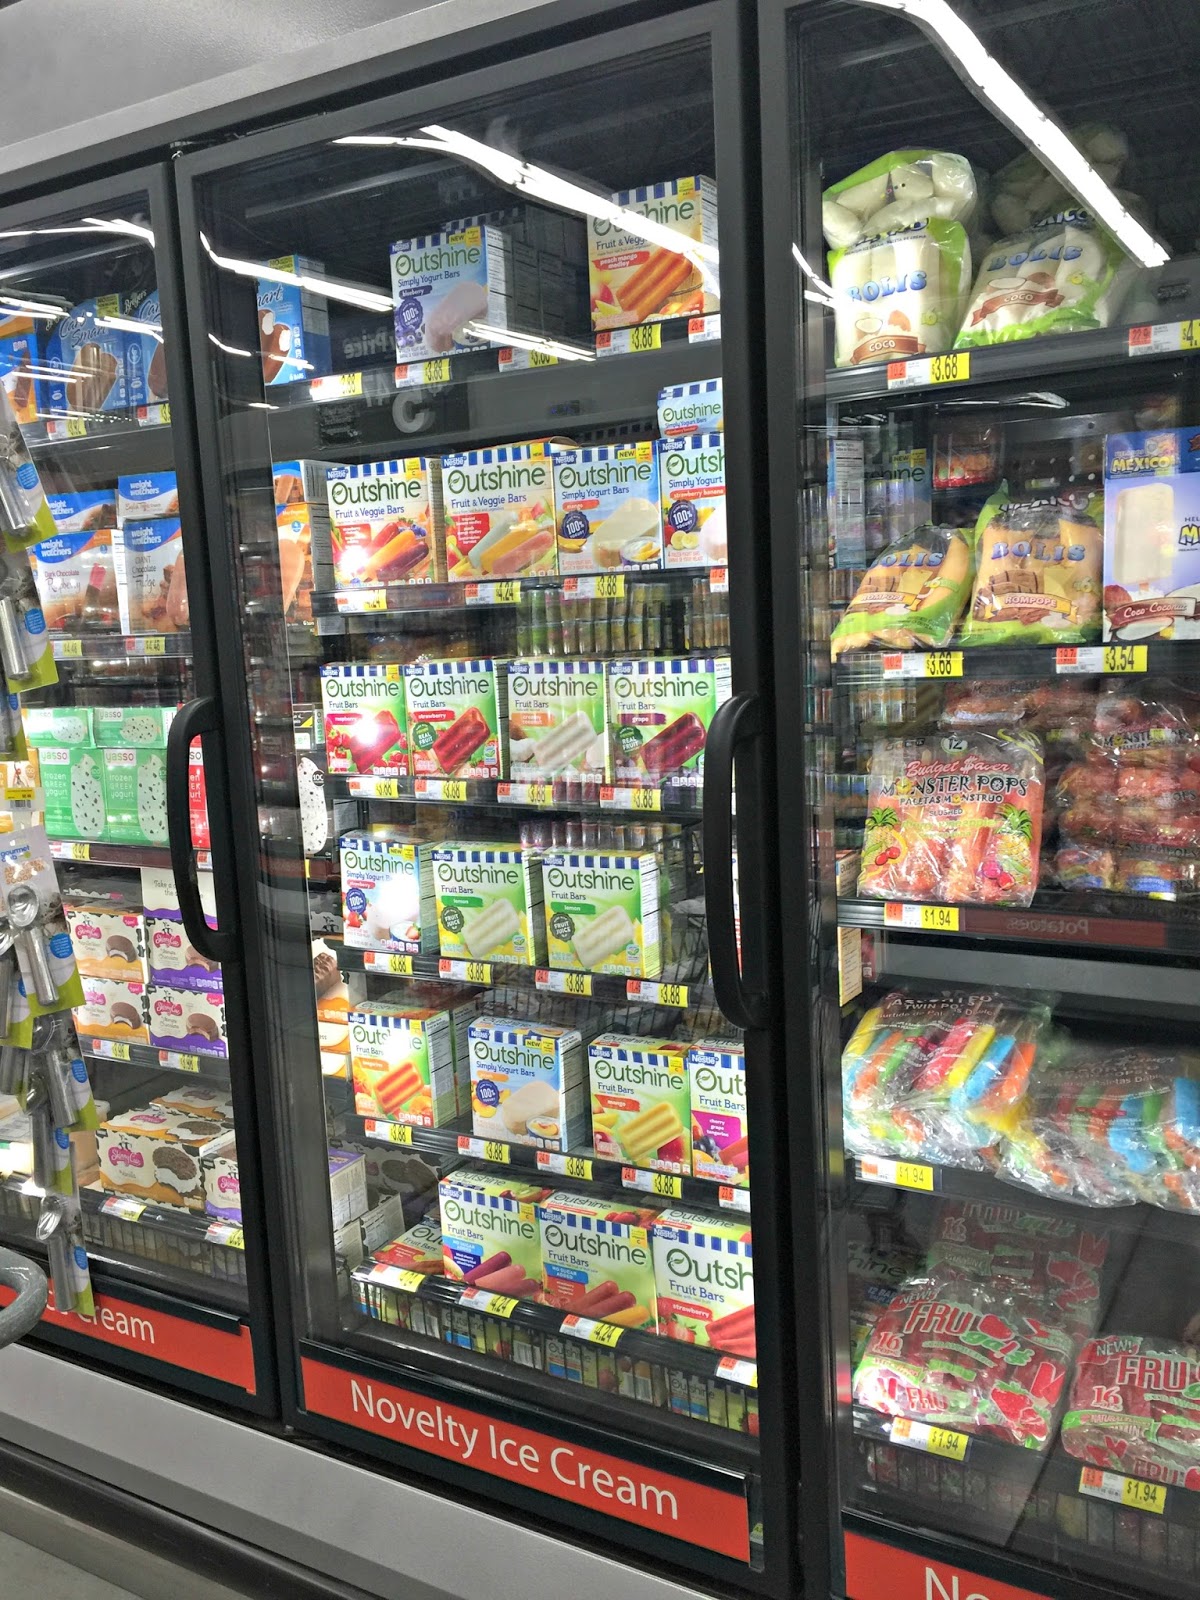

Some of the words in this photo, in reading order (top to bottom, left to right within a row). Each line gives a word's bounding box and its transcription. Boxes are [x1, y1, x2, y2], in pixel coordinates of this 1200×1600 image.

[450, 235, 464, 243] NEW
[596, 238, 617, 251] Fruit
[396, 247, 481, 276] Outshine
[600, 256, 619, 266] peach
[618, 253, 638, 264] mango
[987, 246, 1083, 272] BOLIS
[398, 276, 420, 288] Simply
[421, 274, 443, 285] Yogurt
[444, 271, 461, 279] Bars
[1004, 293, 1034, 303] COCO
[402, 307, 420, 320] 100%
[869, 340, 896, 352] COCO
[931, 354, 959, 381] $3.68
[663, 403, 721, 422] Outshine
[619, 450, 635, 458] NEW
[666, 449, 725, 477] Outsh
[1111, 456, 1170, 474] MEXICO
[447, 464, 546, 495] Outshine
[559, 462, 651, 489] Outshine
[668, 479, 695, 489] Simply
[695, 476, 723, 488] Yogurt
[130, 480, 152, 489] weight
[130, 487, 160, 497] watchers
[331, 478, 421, 505] Outshine
[451, 498, 471, 509] Fruit
[478, 496, 506, 508] Veggie
[507, 493, 527, 504] Bars
[562, 490, 586, 501] Simply
[587, 488, 611, 498] Yogurt
[612, 485, 630, 495] Bars
[673, 490, 702, 499] strawberry
[335, 509, 353, 519] Fruit
[360, 507, 385, 518] Veggie
[387, 505, 405, 515] Bars
[672, 510, 693, 525] 100%
[131, 527, 154, 538] weight
[566, 520, 585, 535] 100%
[40, 539, 63, 549] weight
[131, 535, 162, 545] watchers
[41, 547, 72, 558] watchers
[991, 541, 1086, 562] BOLIS
[56, 569, 80, 578] Chocolate
[861, 592, 905, 603] ROMPOPE
[1005, 596, 1057, 607] ROMPOPE
[1105, 646, 1135, 672] $3.54
[326, 678, 399, 698] Outshine
[409, 676, 489, 697] Outshine
[512, 676, 598, 697] Outshine
[614, 676, 709, 698] Outshine
[329, 701, 343, 709] Fruit
[413, 701, 429, 709] Fruit
[430, 700, 446, 708] Bars
[515, 700, 533, 708] Fruit
[533, 700, 549, 709] Bars
[617, 702, 636, 710] Fruit
[637, 702, 656, 710] Bars
[418, 712, 447, 720] strawberry
[418, 732, 432, 740] REAL
[41, 750, 68, 761] yasso
[105, 751, 135, 763] yasso
[44, 772, 67, 781] frozen
[906, 760, 960, 778] Budget
[109, 775, 133, 783] frozen
[976, 775, 1029, 797] POPS
[45, 788, 69, 799] yogurt
[110, 790, 135, 800] yogurt
[899, 796, 941, 806] PALETAS
[344, 851, 414, 875] Outshine
[346, 870, 365, 881] Simply
[366, 872, 385, 881] Yogurt
[438, 863, 518, 884] Outshine
[548, 868, 634, 891] Outshine
[441, 885, 457, 894] Fruit
[458, 886, 474, 894] Bars
[551, 891, 569, 900] Fruit
[569, 892, 587, 900] Bars
[554, 921, 570, 930] FRUIT
[924, 911, 952, 927] $1.94
[555, 926, 571, 935] JUICE
[566, 974, 585, 993] $3.88
[660, 985, 681, 1005] $3.88
[526, 1040, 541, 1048] NEW
[474, 1041, 555, 1071] Outshine
[476, 1060, 497, 1072] Simply
[497, 1064, 520, 1076] Yogurt
[520, 1068, 536, 1077] Bars
[594, 1060, 683, 1090] Outshine
[478, 1087, 497, 1100] 100%
[597, 1081, 617, 1092] Fruit
[617, 1085, 635, 1095] Bars
[699, 1094, 722, 1108] Fruit
[724, 1098, 745, 1111] Bars
[709, 1118, 726, 1126] cherry
[655, 1175, 674, 1195] $3.88
[553, 1193, 612, 1211] Outshine
[444, 1200, 535, 1239] Outshine
[669, 1209, 735, 1229] Outshine
[447, 1223, 466, 1235] Fruit
[466, 1229, 484, 1241] Bars
[544, 1224, 646, 1265] Outshine
[548, 1250, 569, 1263] Fruit
[570, 1255, 589, 1268] Bars
[666, 1248, 754, 1291] Outsh
[669, 1279, 697, 1297] Fruit
[699, 1286, 725, 1303] Bars
[672, 1303, 710, 1319] strawberry
[1096, 1340, 1133, 1357] NEW!
[1091, 1386, 1122, 1406] 16
[931, 1431, 958, 1451] $1.94
[350, 1379, 480, 1459] Novelty
[489, 1424, 539, 1474] Ice
[549, 1447, 678, 1521] Cream
[1127, 1480, 1158, 1503] $1.94
